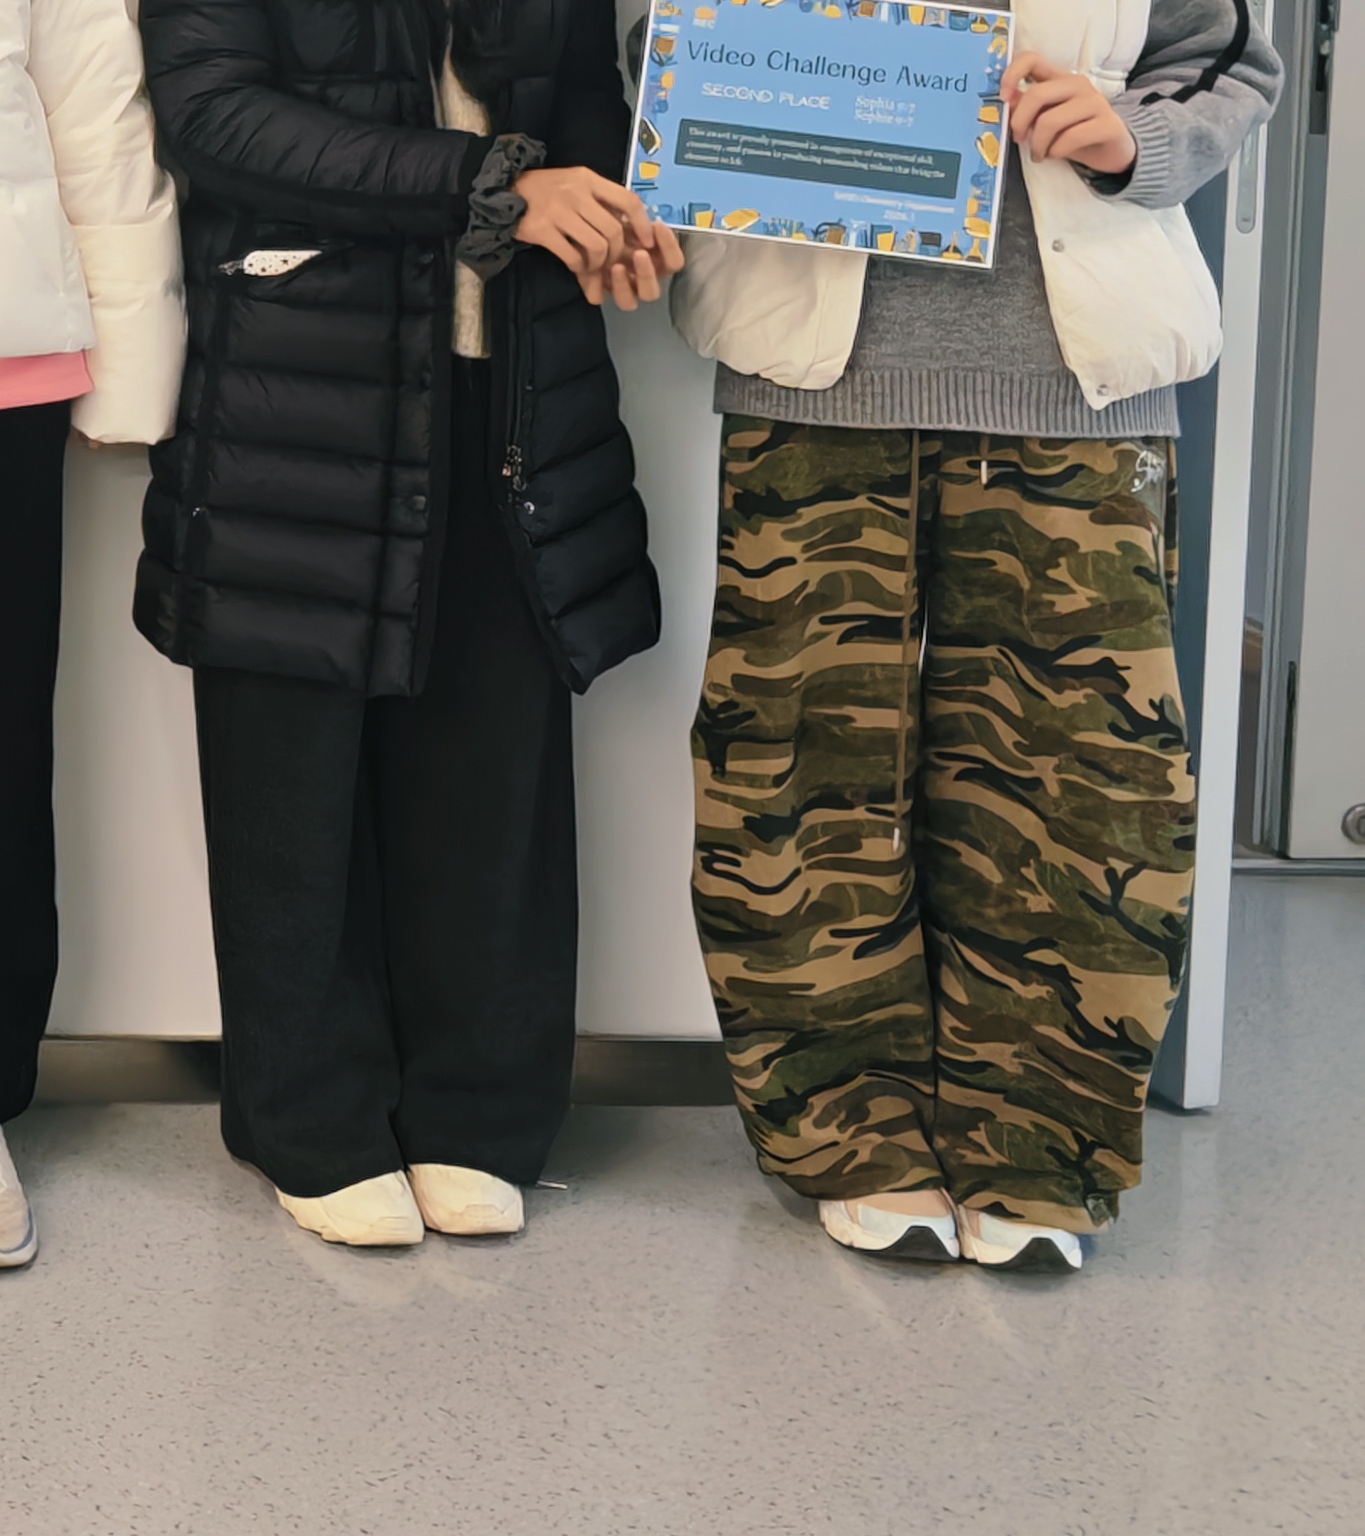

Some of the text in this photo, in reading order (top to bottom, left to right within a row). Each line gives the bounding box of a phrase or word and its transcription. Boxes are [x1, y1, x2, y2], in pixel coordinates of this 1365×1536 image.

[687, 39, 968, 93] Video Challenge Award
[701, 82, 831, 110] SECOND PLACE
